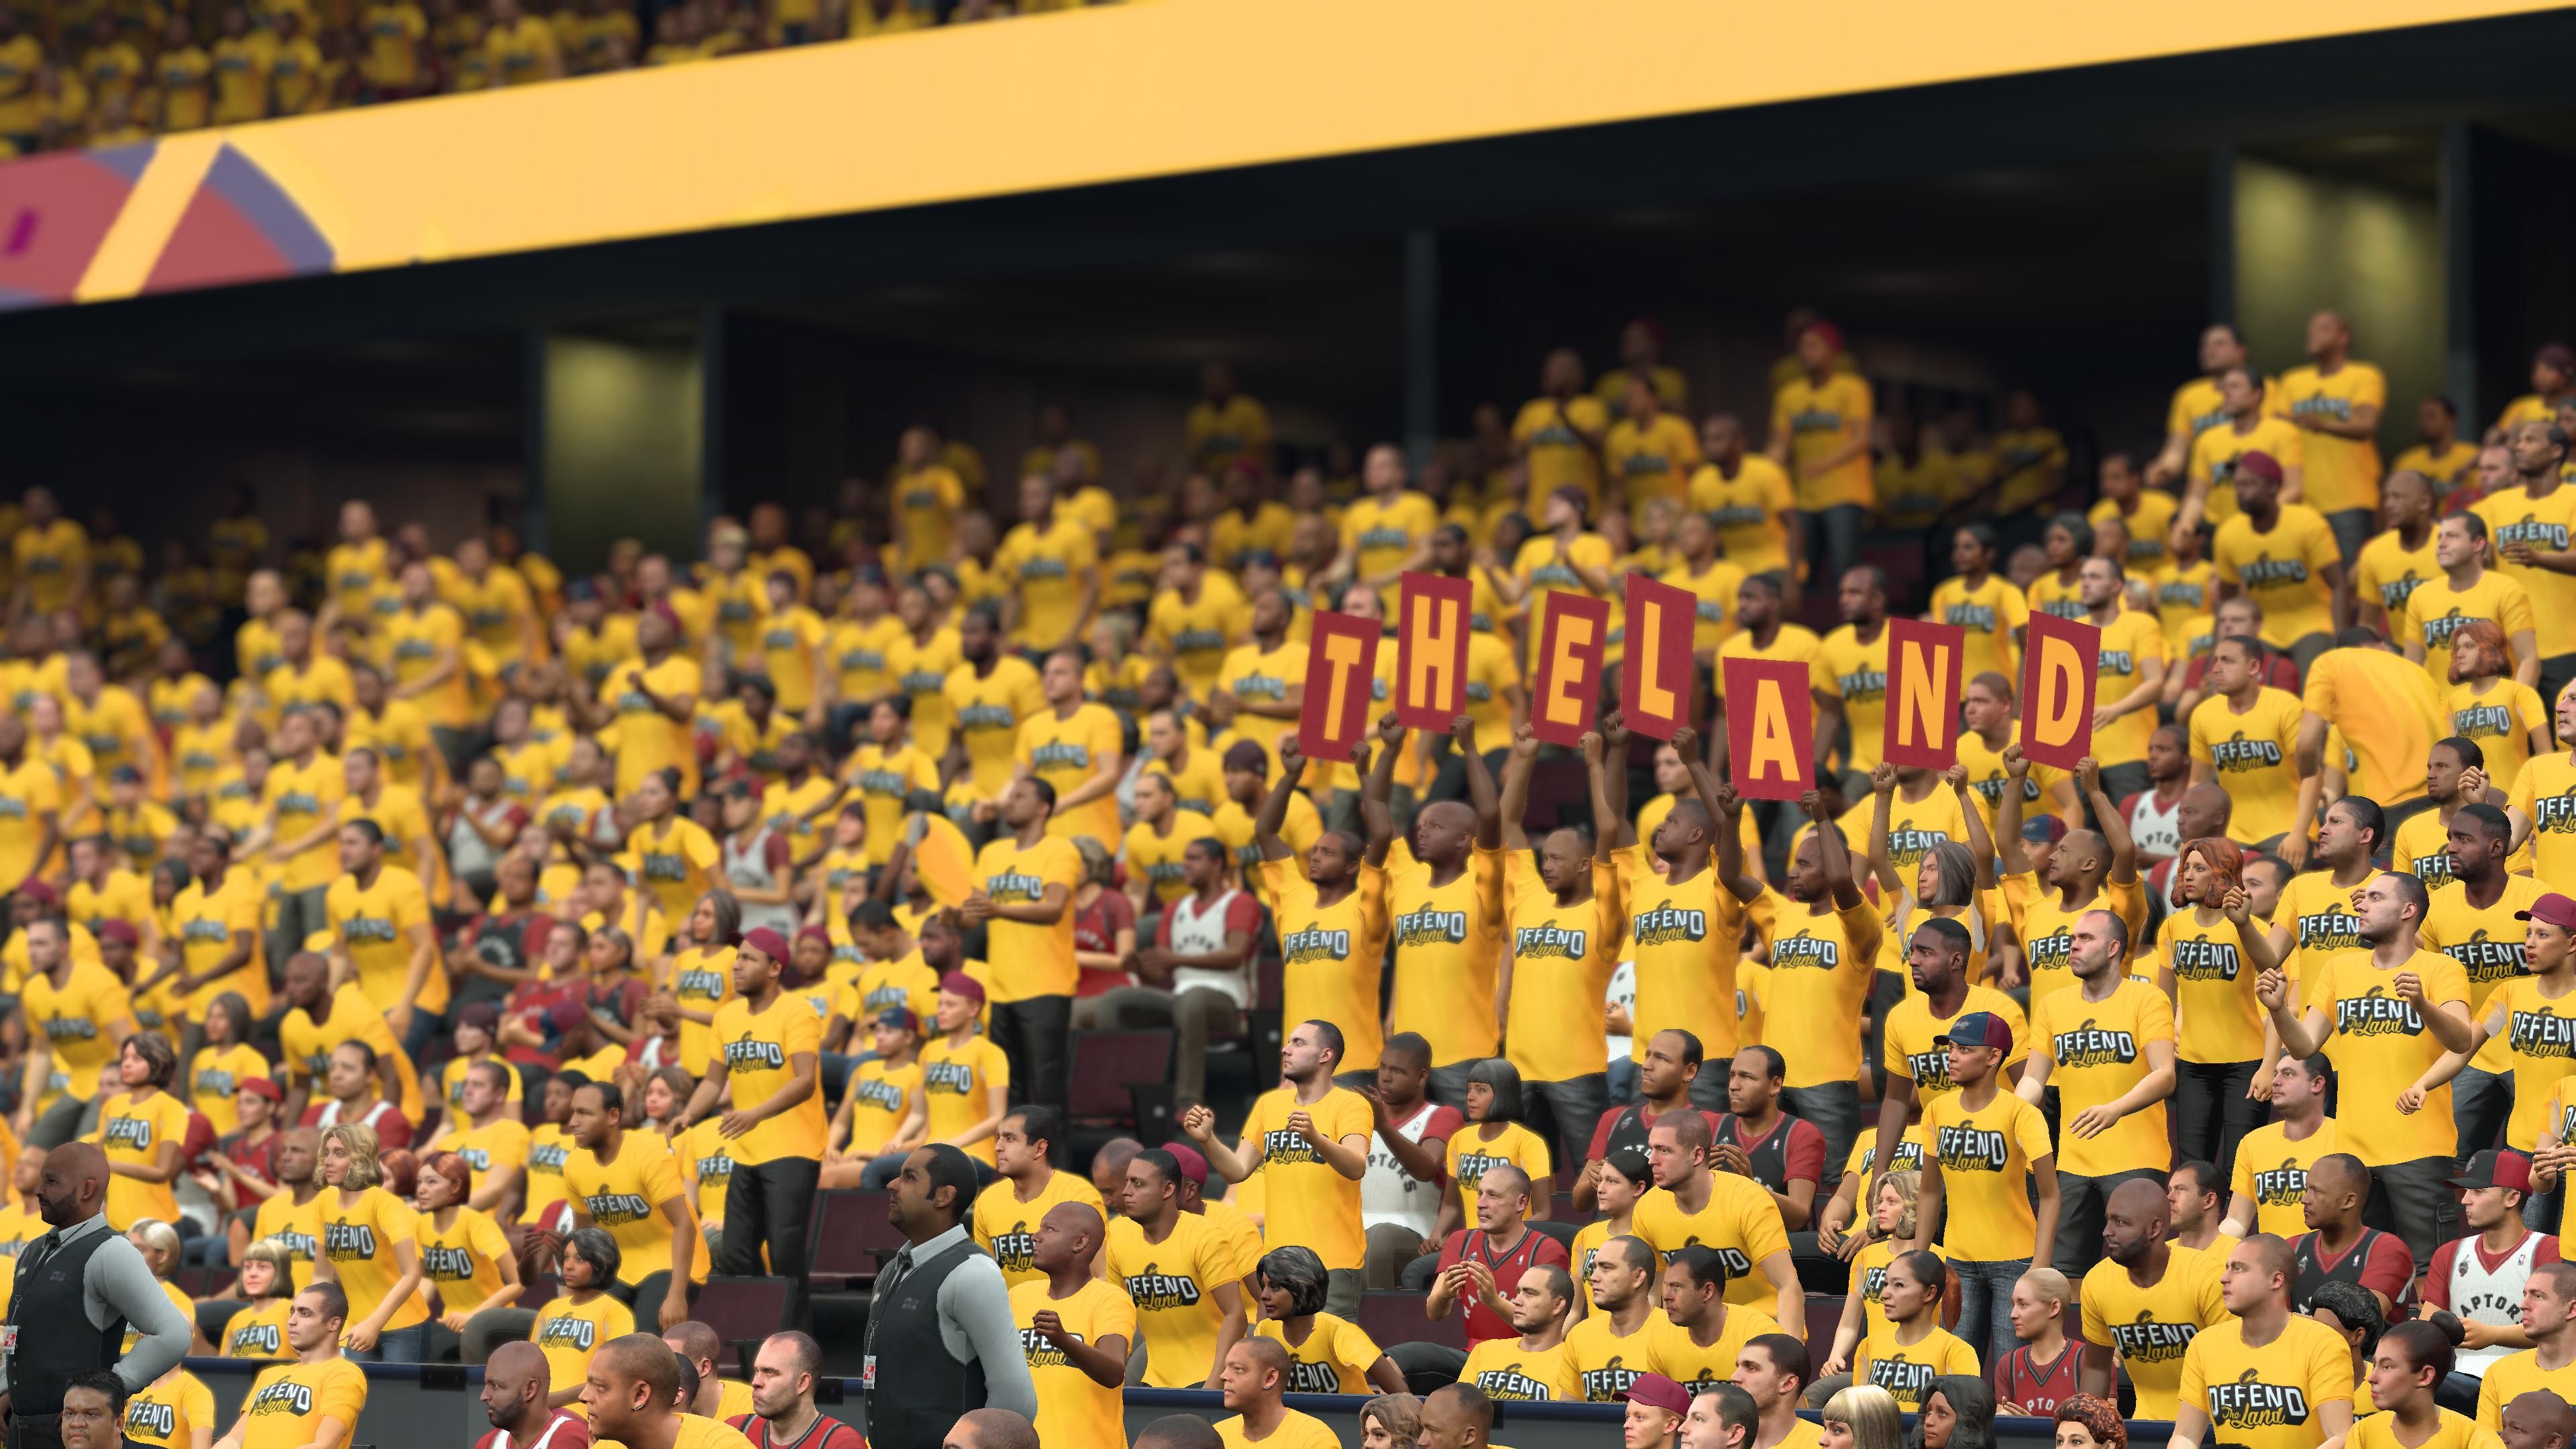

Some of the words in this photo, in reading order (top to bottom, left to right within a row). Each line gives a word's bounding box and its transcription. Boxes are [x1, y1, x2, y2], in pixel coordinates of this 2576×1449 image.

[2456, 706, 2510, 731] DEFEND
[2467, 724, 2497, 740] Land
[2210, 740, 2281, 765] DEFEND
[2231, 754, 2267, 773] Land
[1896, 849, 1923, 867] Lan
[1397, 913, 1464, 940] DEFEND
[1635, 910, 1704, 938] DEFEND
[1649, 925, 1686, 945] Land
[2298, 914, 2360, 941] DEFEN
[1285, 931, 1348, 957] DEFEND
[1411, 928, 1448, 947] Land
[1517, 927, 1583, 955] DEFEND
[2316, 928, 2361, 950] Land
[1297, 945, 1332, 963] Land
[1531, 940, 1567, 958] Land
[1773, 938, 1836, 966] DEFEND
[1786, 951, 1820, 969] Land
[2030, 936, 2071, 965] DEFE
[2045, 951, 2071, 969] Lan
[2174, 942, 2237, 975] DEFEND
[2184, 961, 2223, 981] Land
[2471, 958, 2516, 982] Land
[2337, 1000, 2423, 1028] DEFEND
[2355, 1014, 2404, 1036] Land
[2512, 1013, 2576, 1042] DEFEN
[725, 1042, 783, 1065] DEFEND
[2054, 1031, 2135, 1059] DEFEND
[2524, 1036, 2570, 1058] Land
[2075, 1046, 2118, 1067] Land
[1276, 1144, 1313, 1163] Land
[1937, 1127, 2005, 1165] DEFEND
[1950, 1150, 1989, 1171] Land
[2265, 1189, 2279, 1200] The
[2273, 1185, 2306, 1205] Lan
[1142, 1293, 1182, 1311] Land
[2461, 1293, 2522, 1324] APTOR
[1027, 1348, 1067, 1367] Land
[2138, 1342, 2186, 1362] Land
[1477, 1371, 1548, 1400] DEFEND
[261, 1397, 292, 1415] Land
[2208, 1385, 2306, 1417] DEFEND
[2222, 1406, 2241, 1420] The
[2236, 1403, 2286, 1429] Land
